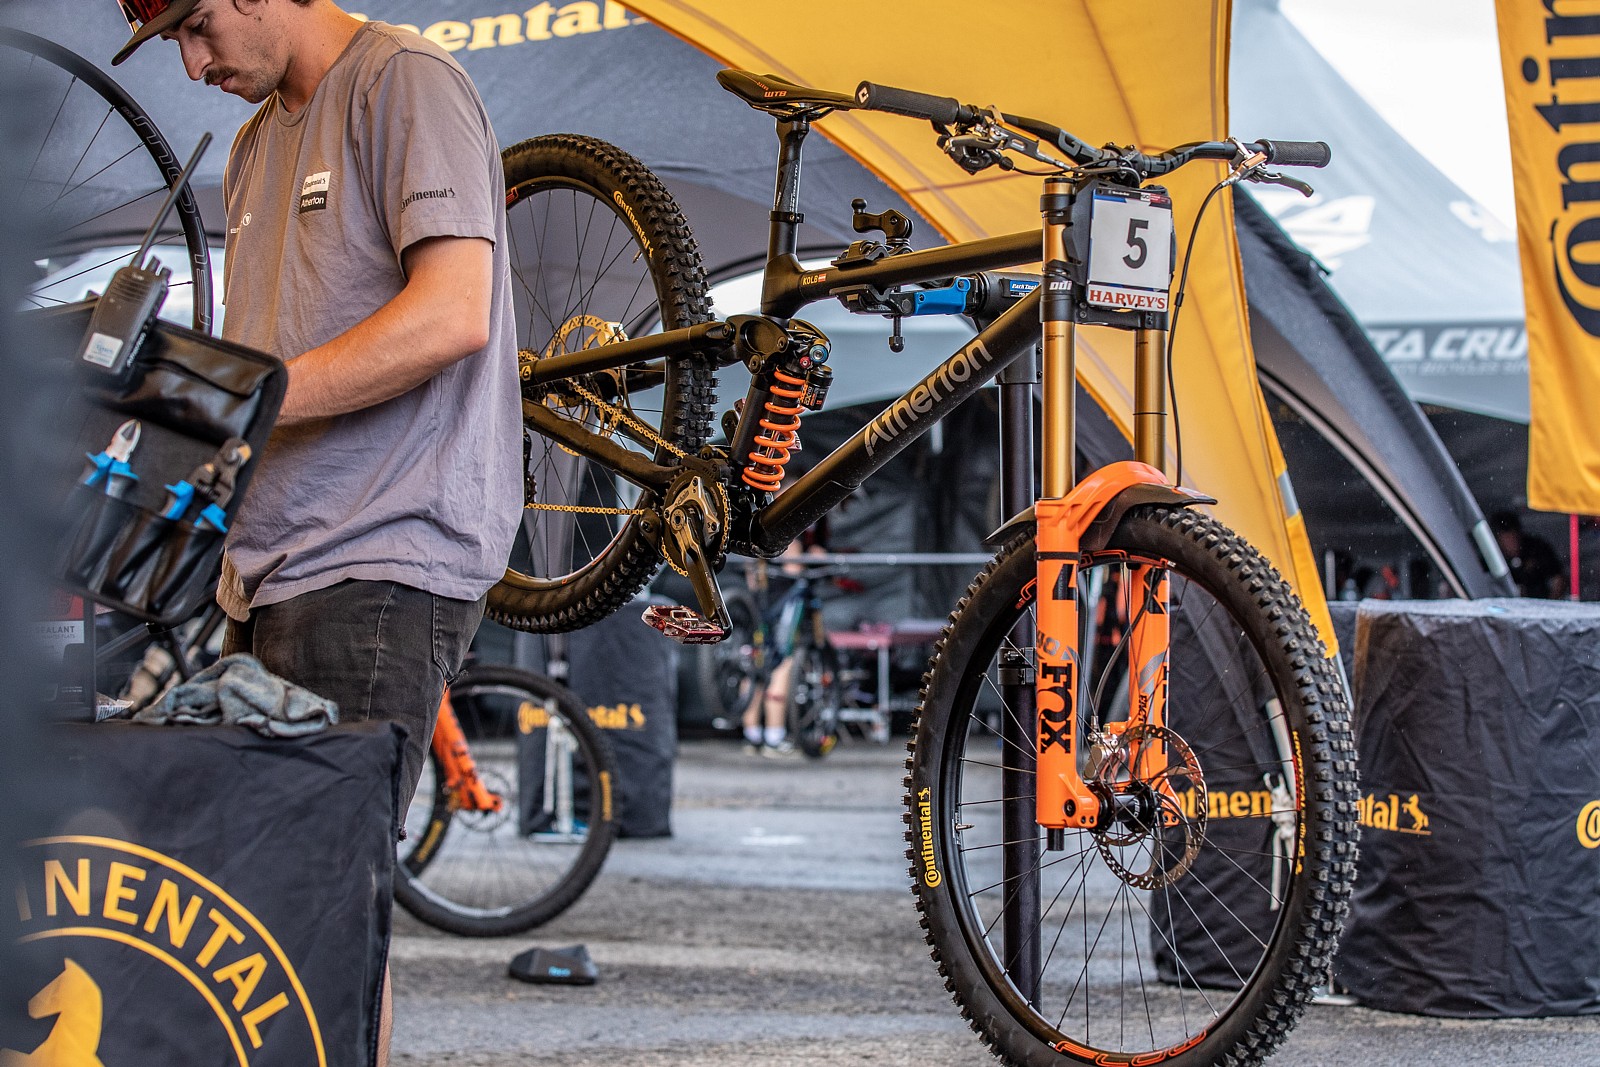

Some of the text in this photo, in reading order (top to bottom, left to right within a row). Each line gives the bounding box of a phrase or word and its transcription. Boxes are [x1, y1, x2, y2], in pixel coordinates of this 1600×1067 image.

[400, 0, 630, 52] ental
[764, 90, 787, 98] WTB
[300, 195, 325, 208] Atherton
[613, 190, 651, 250] Continental
[1122, 217, 1149, 269] 5
[802, 274, 819, 286] KOLB
[1089, 289, 1166, 310] HARVEY'S
[864, 338, 993, 457] Atherton
[1037, 662, 1073, 754] FOX
[918, 798, 942, 889] Continental
